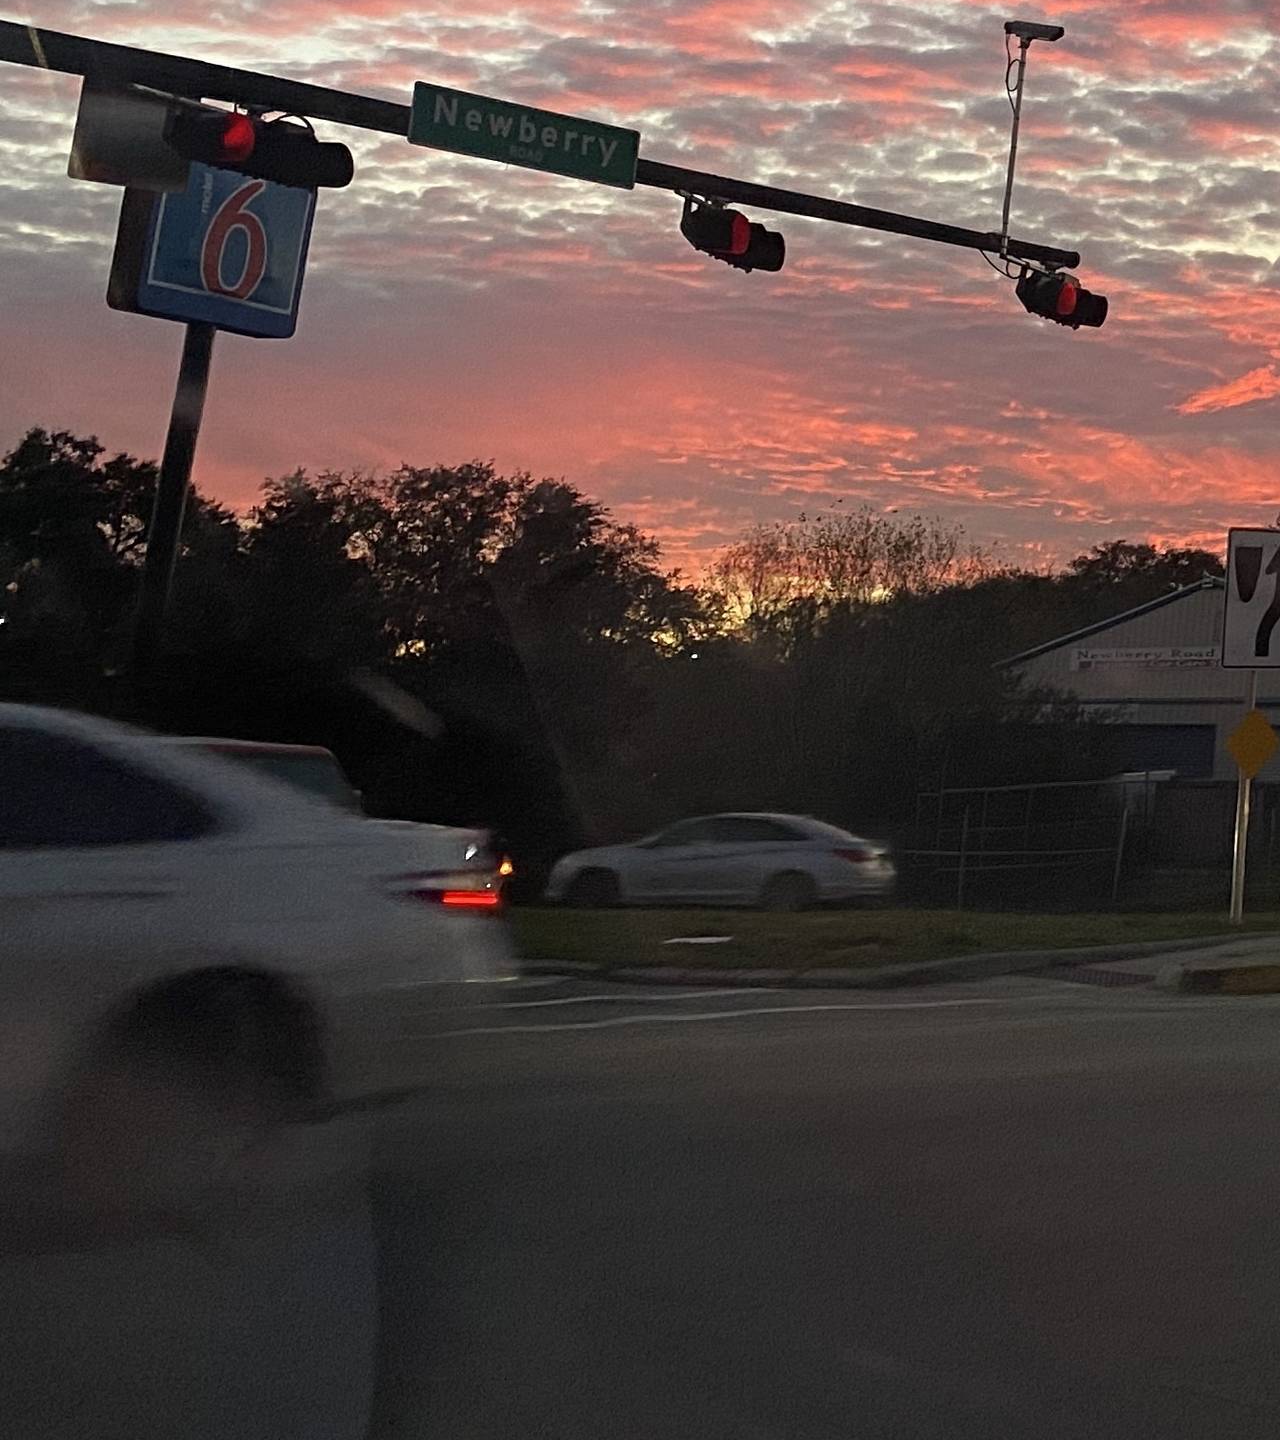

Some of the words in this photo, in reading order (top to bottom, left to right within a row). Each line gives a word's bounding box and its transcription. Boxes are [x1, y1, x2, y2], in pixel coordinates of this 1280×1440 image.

[433, 94, 618, 168] Newberry
[508, 144, 544, 163] ROAD
[200, 177, 267, 301] 6
[1171, 647, 1215, 658] Road
